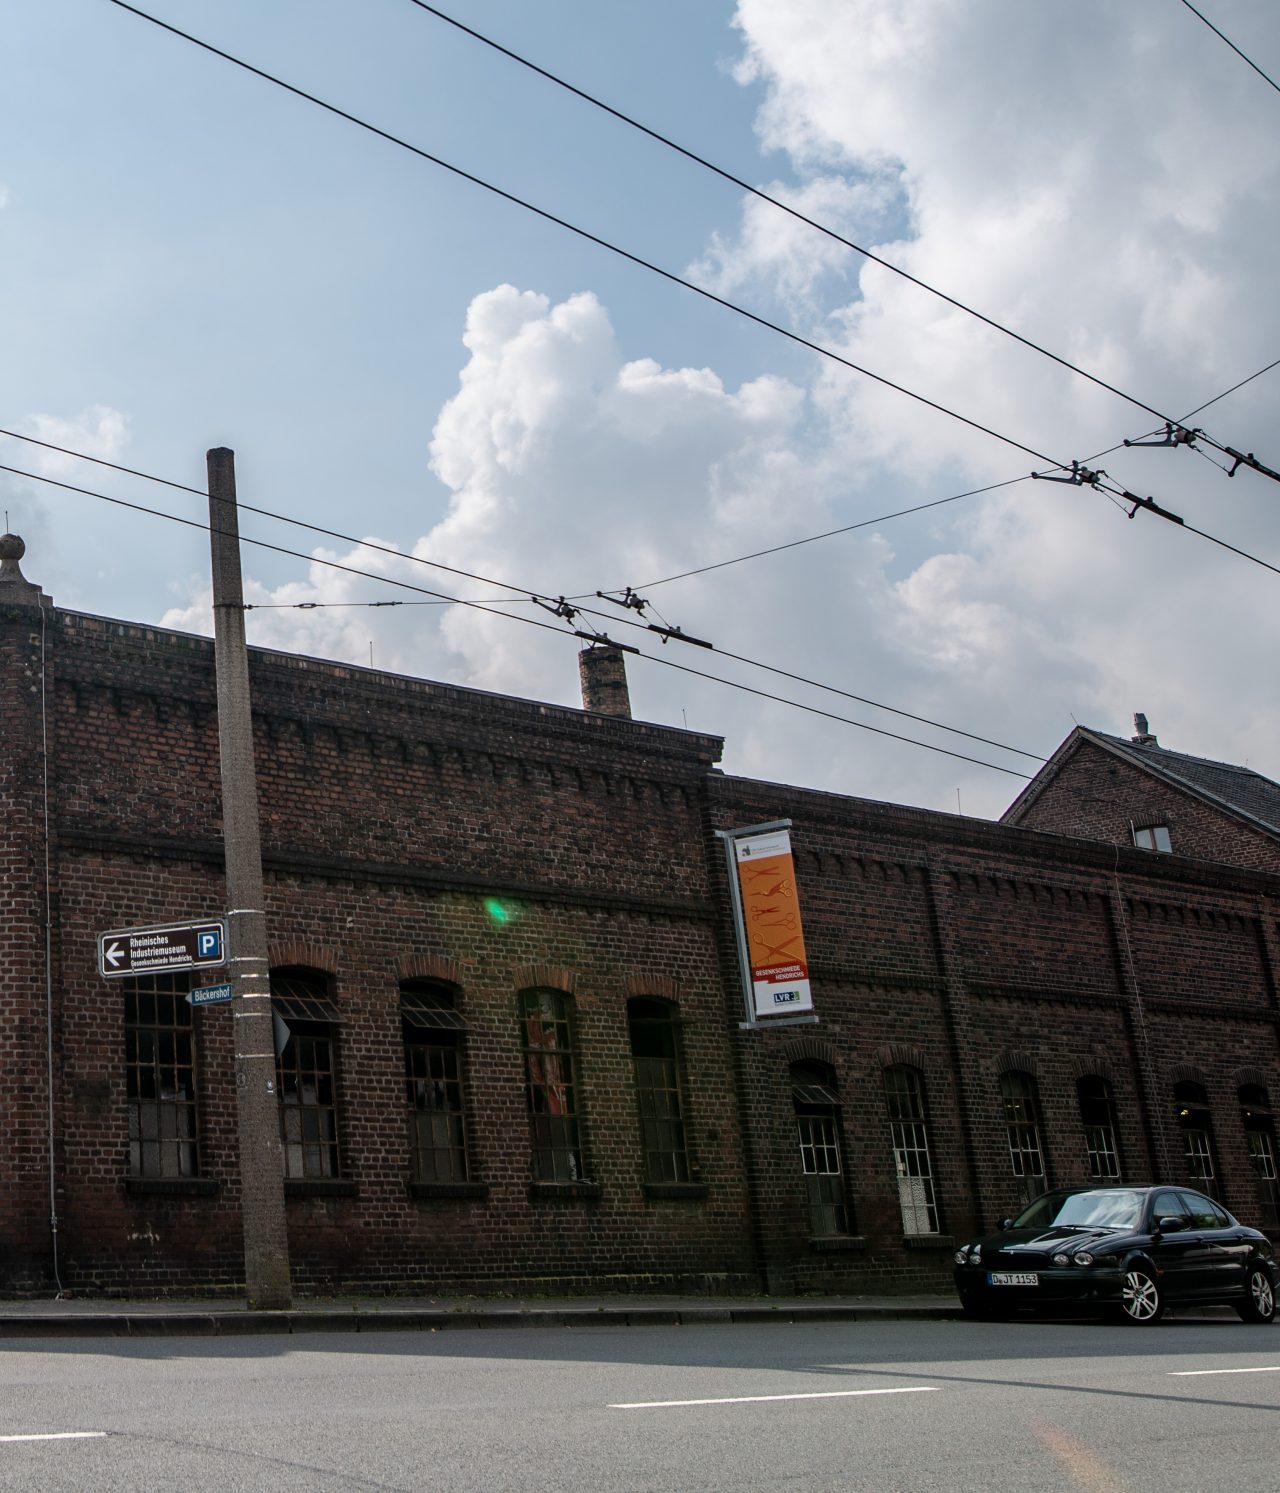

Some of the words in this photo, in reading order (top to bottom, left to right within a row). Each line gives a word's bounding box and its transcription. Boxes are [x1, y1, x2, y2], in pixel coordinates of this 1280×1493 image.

[130, 936, 168, 947] Rheinisches
[202, 935, 215, 954] P
[130, 945, 186, 958] Industriemuseum
[131, 958, 168, 967] Gesenkschmiede
[169, 955, 192, 963] Hendrichs
[755, 965, 800, 976] GESENKSCHMIEDE
[775, 971, 804, 979] HENDRICHS
[194, 986, 230, 1001] Bäckershof
[774, 994, 791, 1002] LVR
